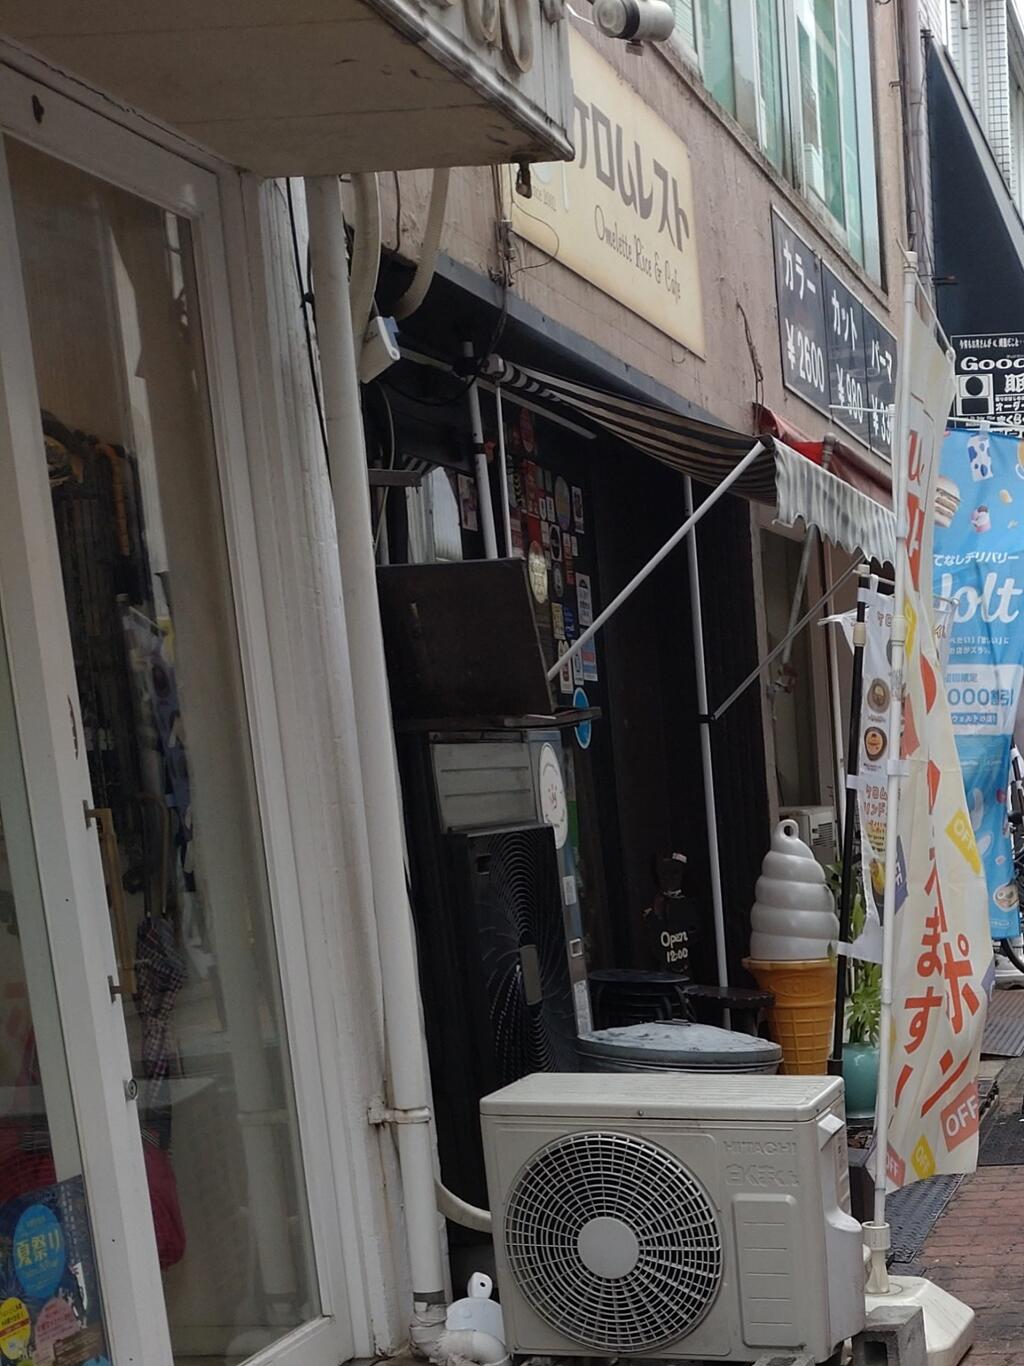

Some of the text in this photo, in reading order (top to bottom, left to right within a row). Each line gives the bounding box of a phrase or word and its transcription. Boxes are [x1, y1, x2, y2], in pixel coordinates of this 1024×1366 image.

[594, 204, 633, 263] Omelette
[633, 234, 652, 278] Rice
[654, 251, 662, 285] &
[783, 239, 816, 300] カラー
[831, 289, 858, 350] カット
[870, 338, 892, 384] パーマ
[836, 363, 864, 425] ¥980
[933, 551, 1020, 567] てなしデリバリー
[660, 931, 688, 949] Open
[945, 1095, 978, 1137] OFF
[722, 1140, 798, 1157] HITACHI
